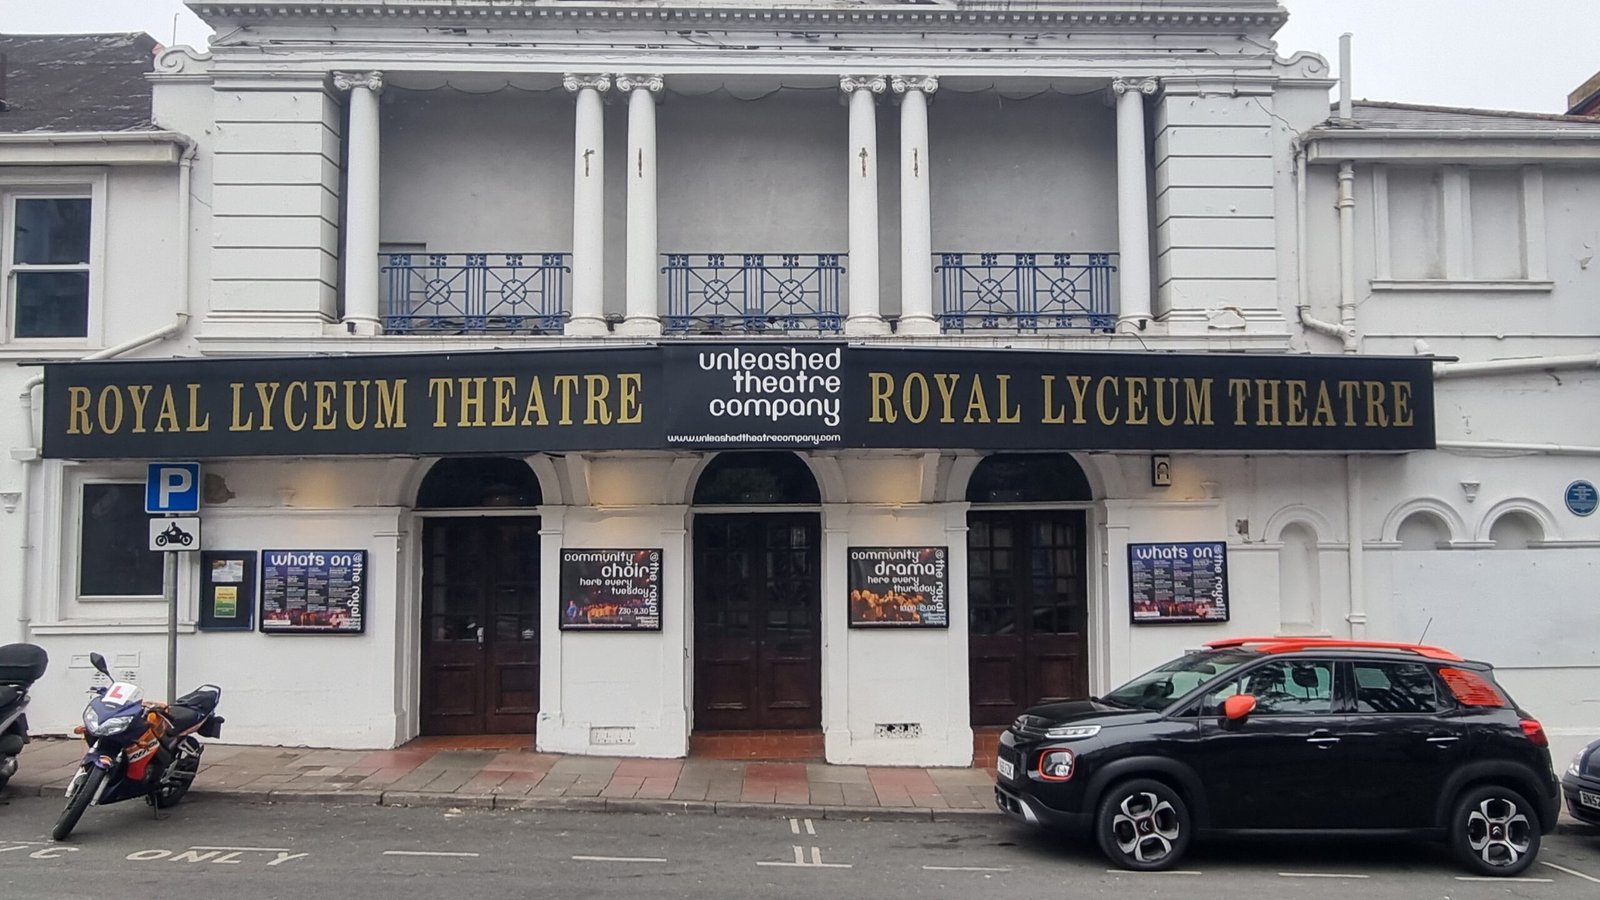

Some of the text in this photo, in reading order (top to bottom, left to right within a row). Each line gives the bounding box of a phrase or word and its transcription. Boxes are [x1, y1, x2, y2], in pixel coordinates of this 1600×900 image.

[699, 348, 841, 370] unleashed
[733, 370, 841, 393] theatre
[66, 373, 643, 435] ROYAL LYCEUM THEATRE
[868, 372, 1414, 428] ROYAL LYCEUM THEATRE
[709, 398, 841, 427] company
[667, 433, 841, 444] www.unleashedtheatrecompany.com
[159, 467, 193, 508] P
[271, 552, 352, 566] whats on
[564, 551, 635, 566] community
[851, 549, 919, 563] community
[1137, 545, 1213, 559] whats on
[601, 563, 650, 578] choir
[874, 561, 935, 575] drama
[580, 578, 633, 589] here every
[867, 576, 919, 587] here every
[611, 587, 650, 598] tuesday
[893, 584, 936, 595] thursday
[932, 582, 945, 612] royal
[1211, 577, 1226, 607] royal
[347, 586, 362, 617] royal
[644, 585, 659, 615] royal
[110, 686, 123, 699] L
[125, 849, 309, 865] ONLY
